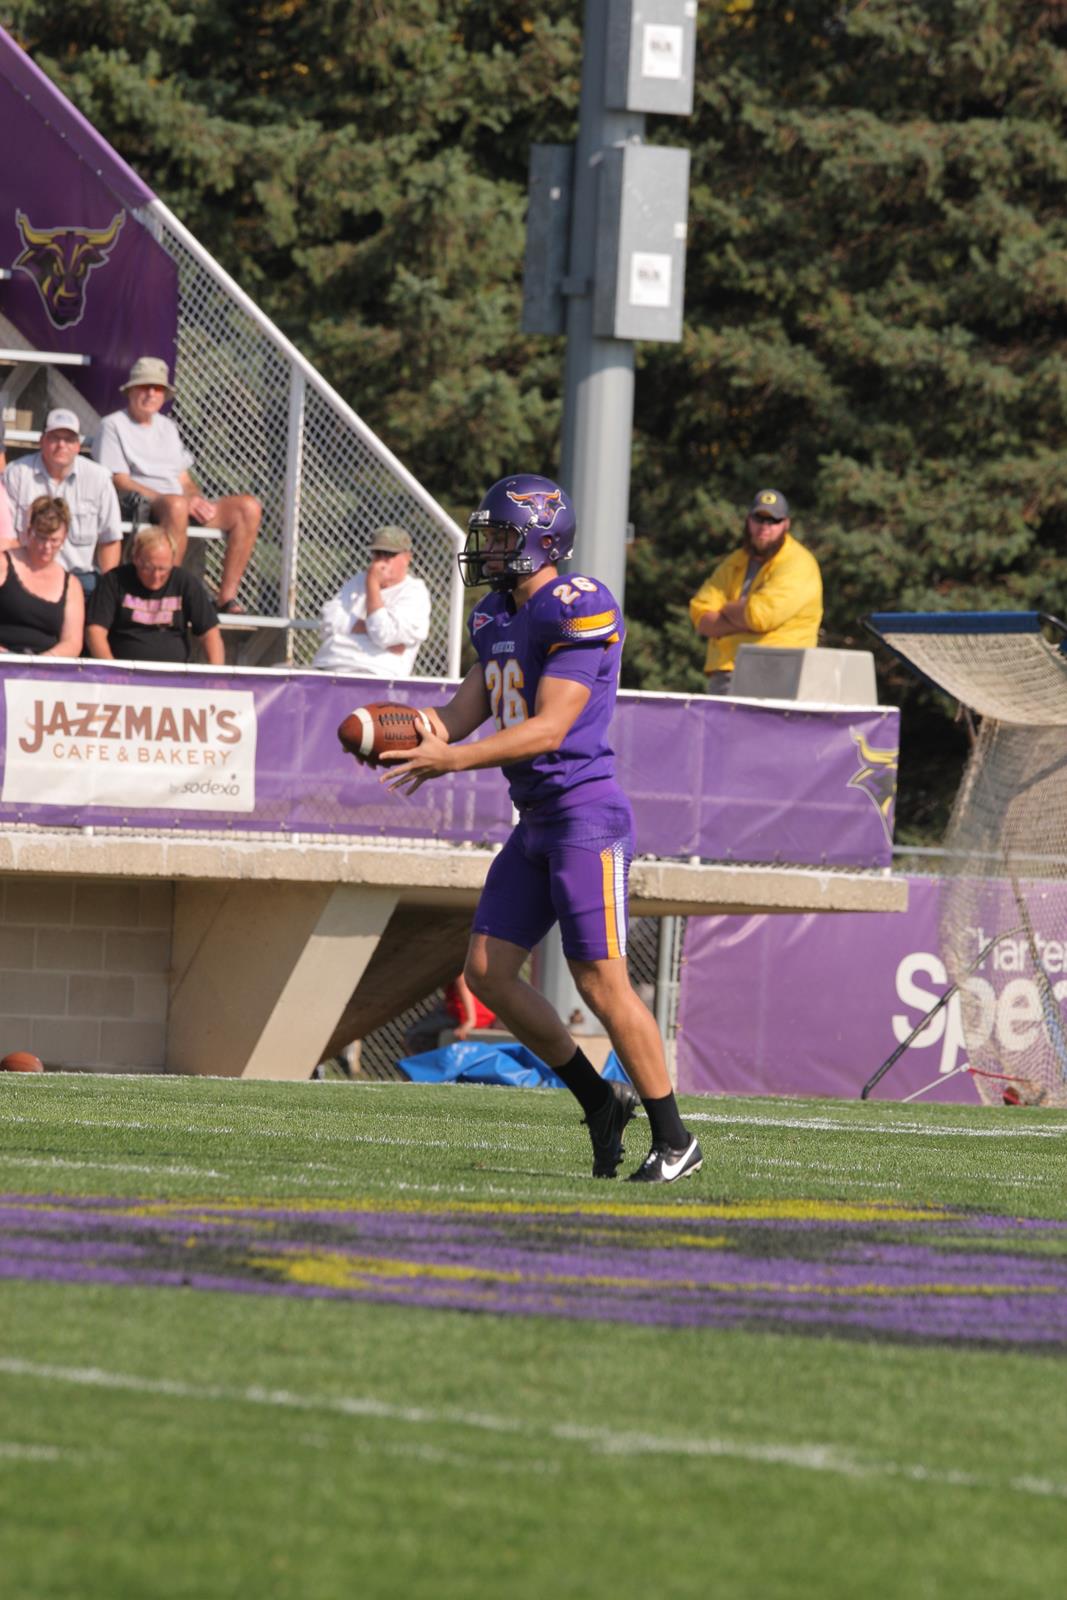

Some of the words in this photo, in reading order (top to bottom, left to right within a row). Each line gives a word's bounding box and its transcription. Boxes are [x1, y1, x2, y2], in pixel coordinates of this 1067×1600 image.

[552, 576, 598, 605] 26
[485, 658, 528, 731] 26
[19, 700, 242, 753] JAZZMAN'S
[53, 743, 109, 762] CAFE
[117, 746, 129, 762] &
[138, 747, 232, 766] BAKERY
[180, 775, 240, 796] sodexo
